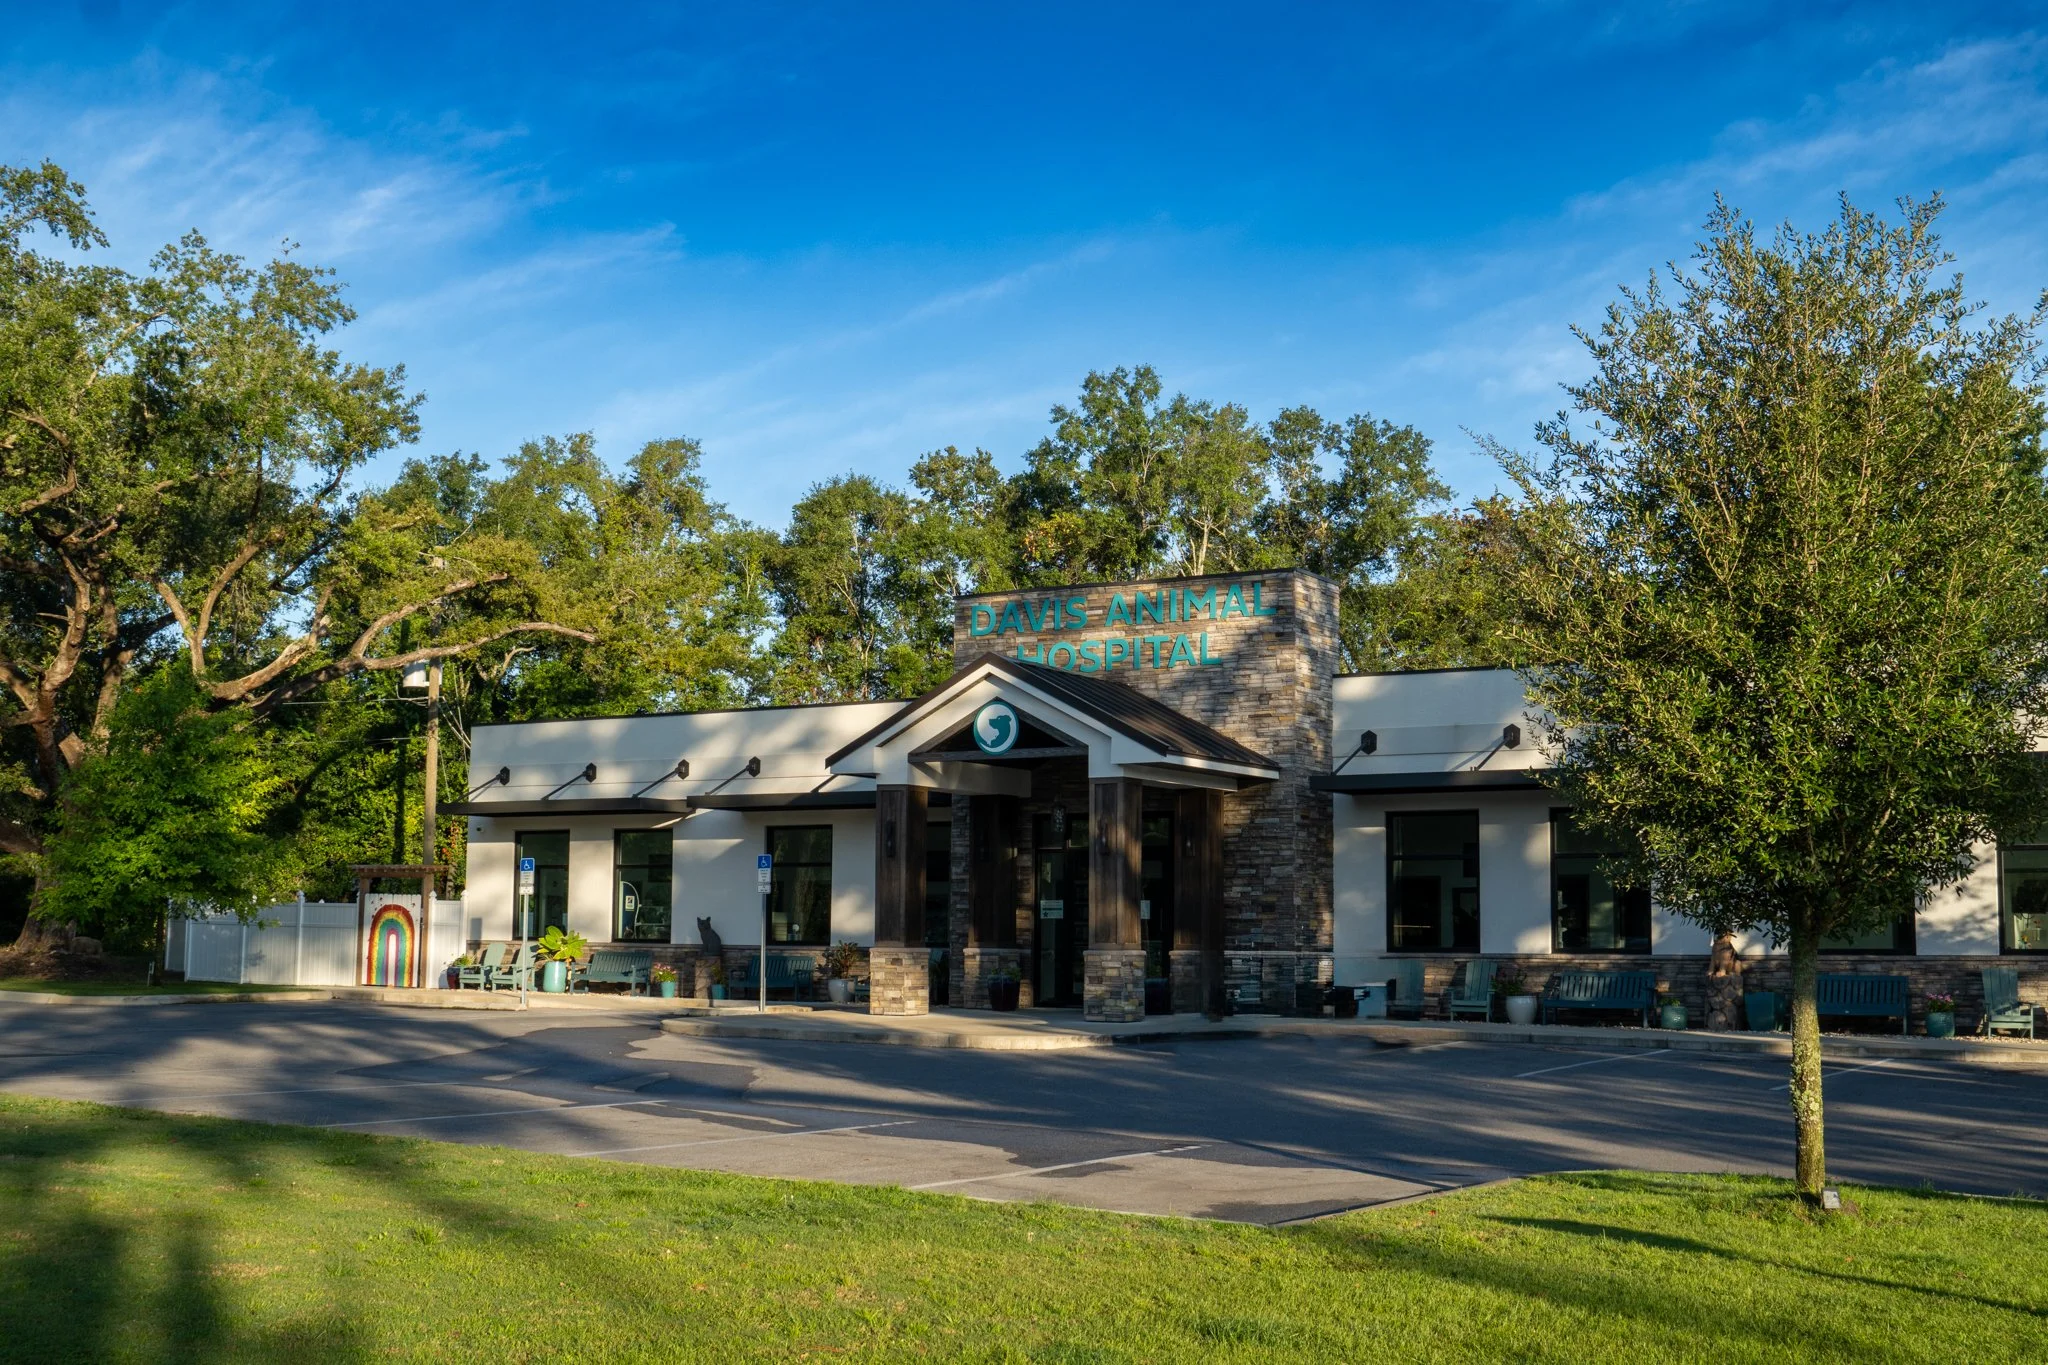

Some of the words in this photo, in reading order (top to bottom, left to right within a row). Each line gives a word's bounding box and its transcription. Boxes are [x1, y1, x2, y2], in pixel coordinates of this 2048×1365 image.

[970, 596, 1088, 637] DAVIS
[1104, 582, 1278, 627] ANIMAL
[1016, 632, 1222, 673] HOSPITAL
